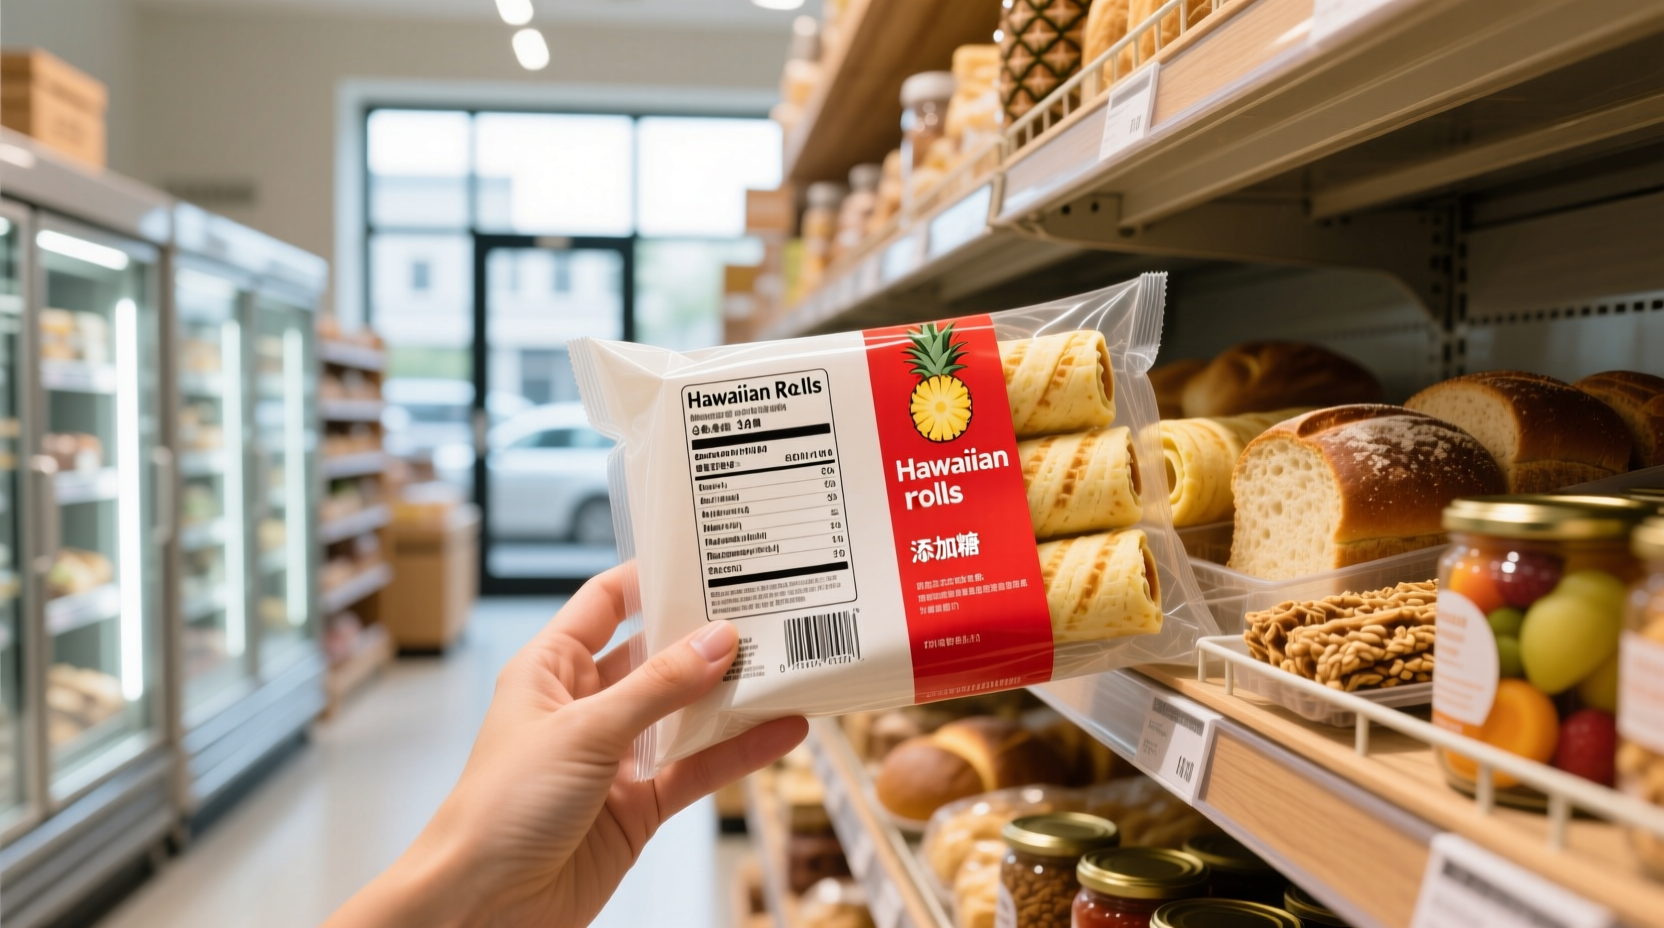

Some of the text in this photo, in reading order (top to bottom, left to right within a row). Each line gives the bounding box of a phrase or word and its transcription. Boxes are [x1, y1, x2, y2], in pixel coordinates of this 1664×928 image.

[688, 384, 771, 409] Hawaiian
[896, 447, 1010, 483] Hawaiian
[904, 480, 964, 511] rolls
[910, 531, 980, 564] 添加糖
